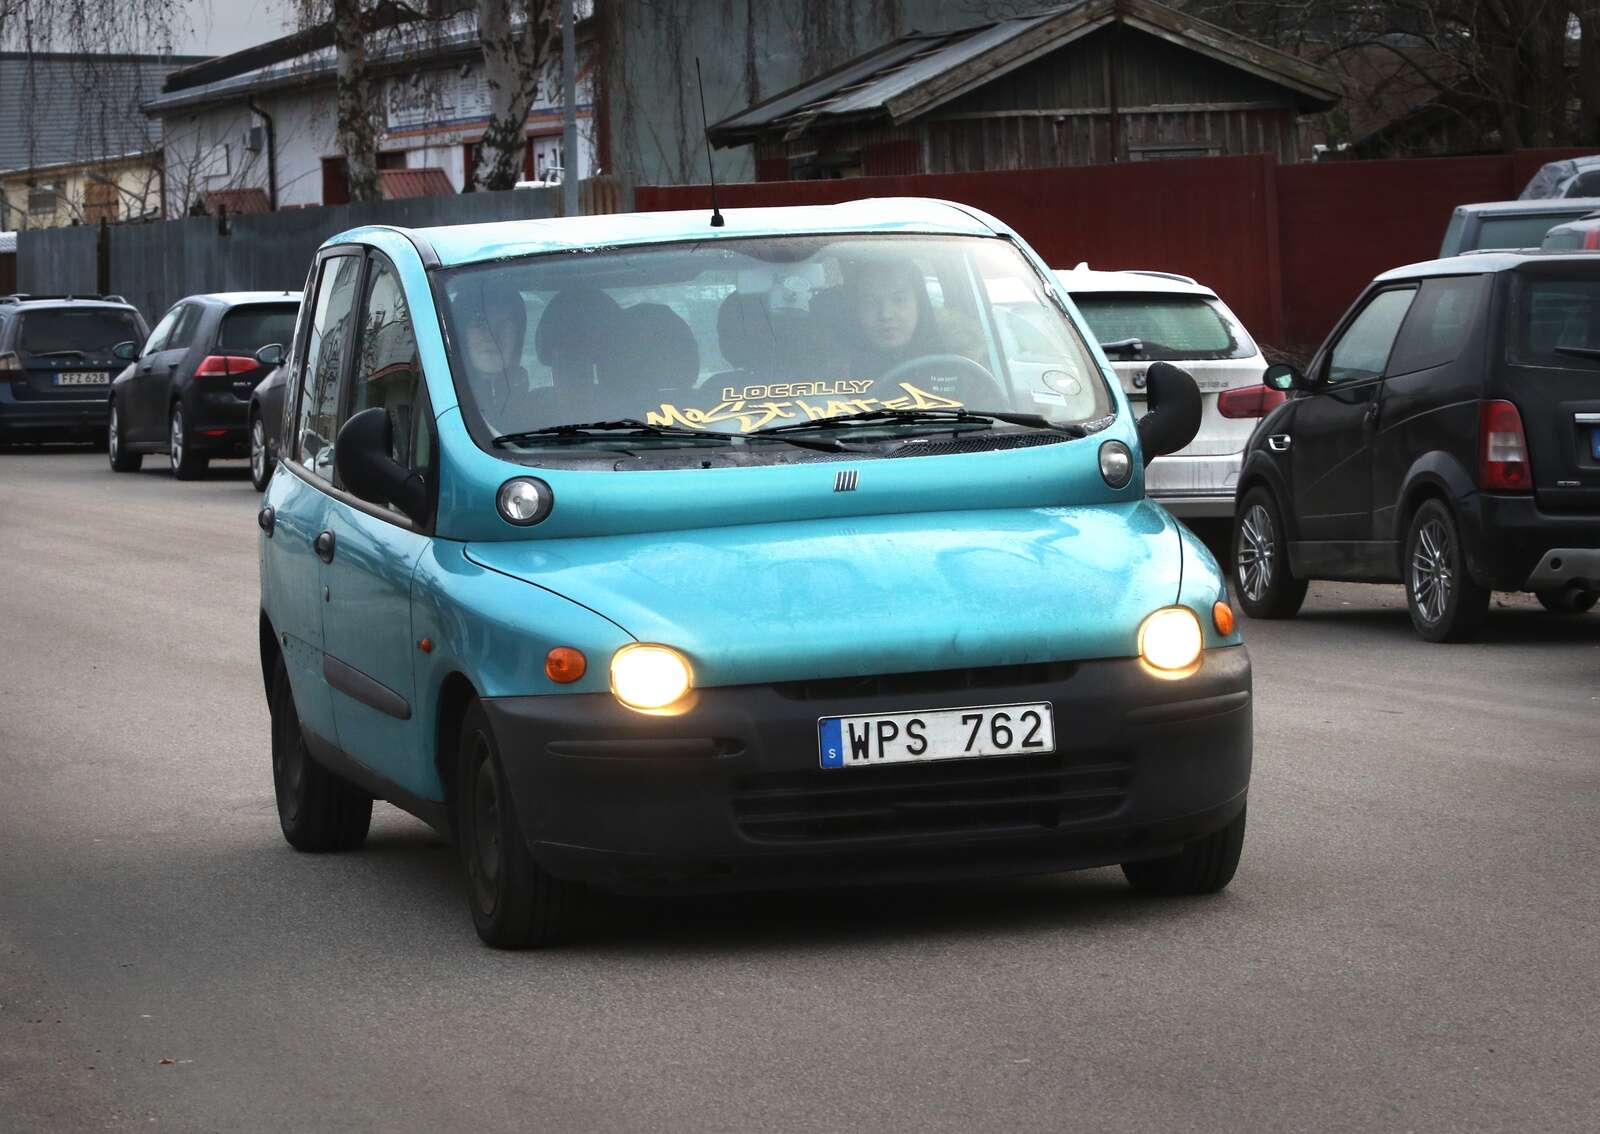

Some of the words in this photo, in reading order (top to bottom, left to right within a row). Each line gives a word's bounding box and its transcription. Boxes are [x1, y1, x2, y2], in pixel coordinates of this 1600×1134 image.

[62, 373, 82, 384] FFZ
[85, 373, 105, 384] 628
[722, 379, 874, 401] LOCALLY
[848, 718, 928, 760] WPS
[961, 710, 1044, 752] 762
[828, 748, 837, 759] S
